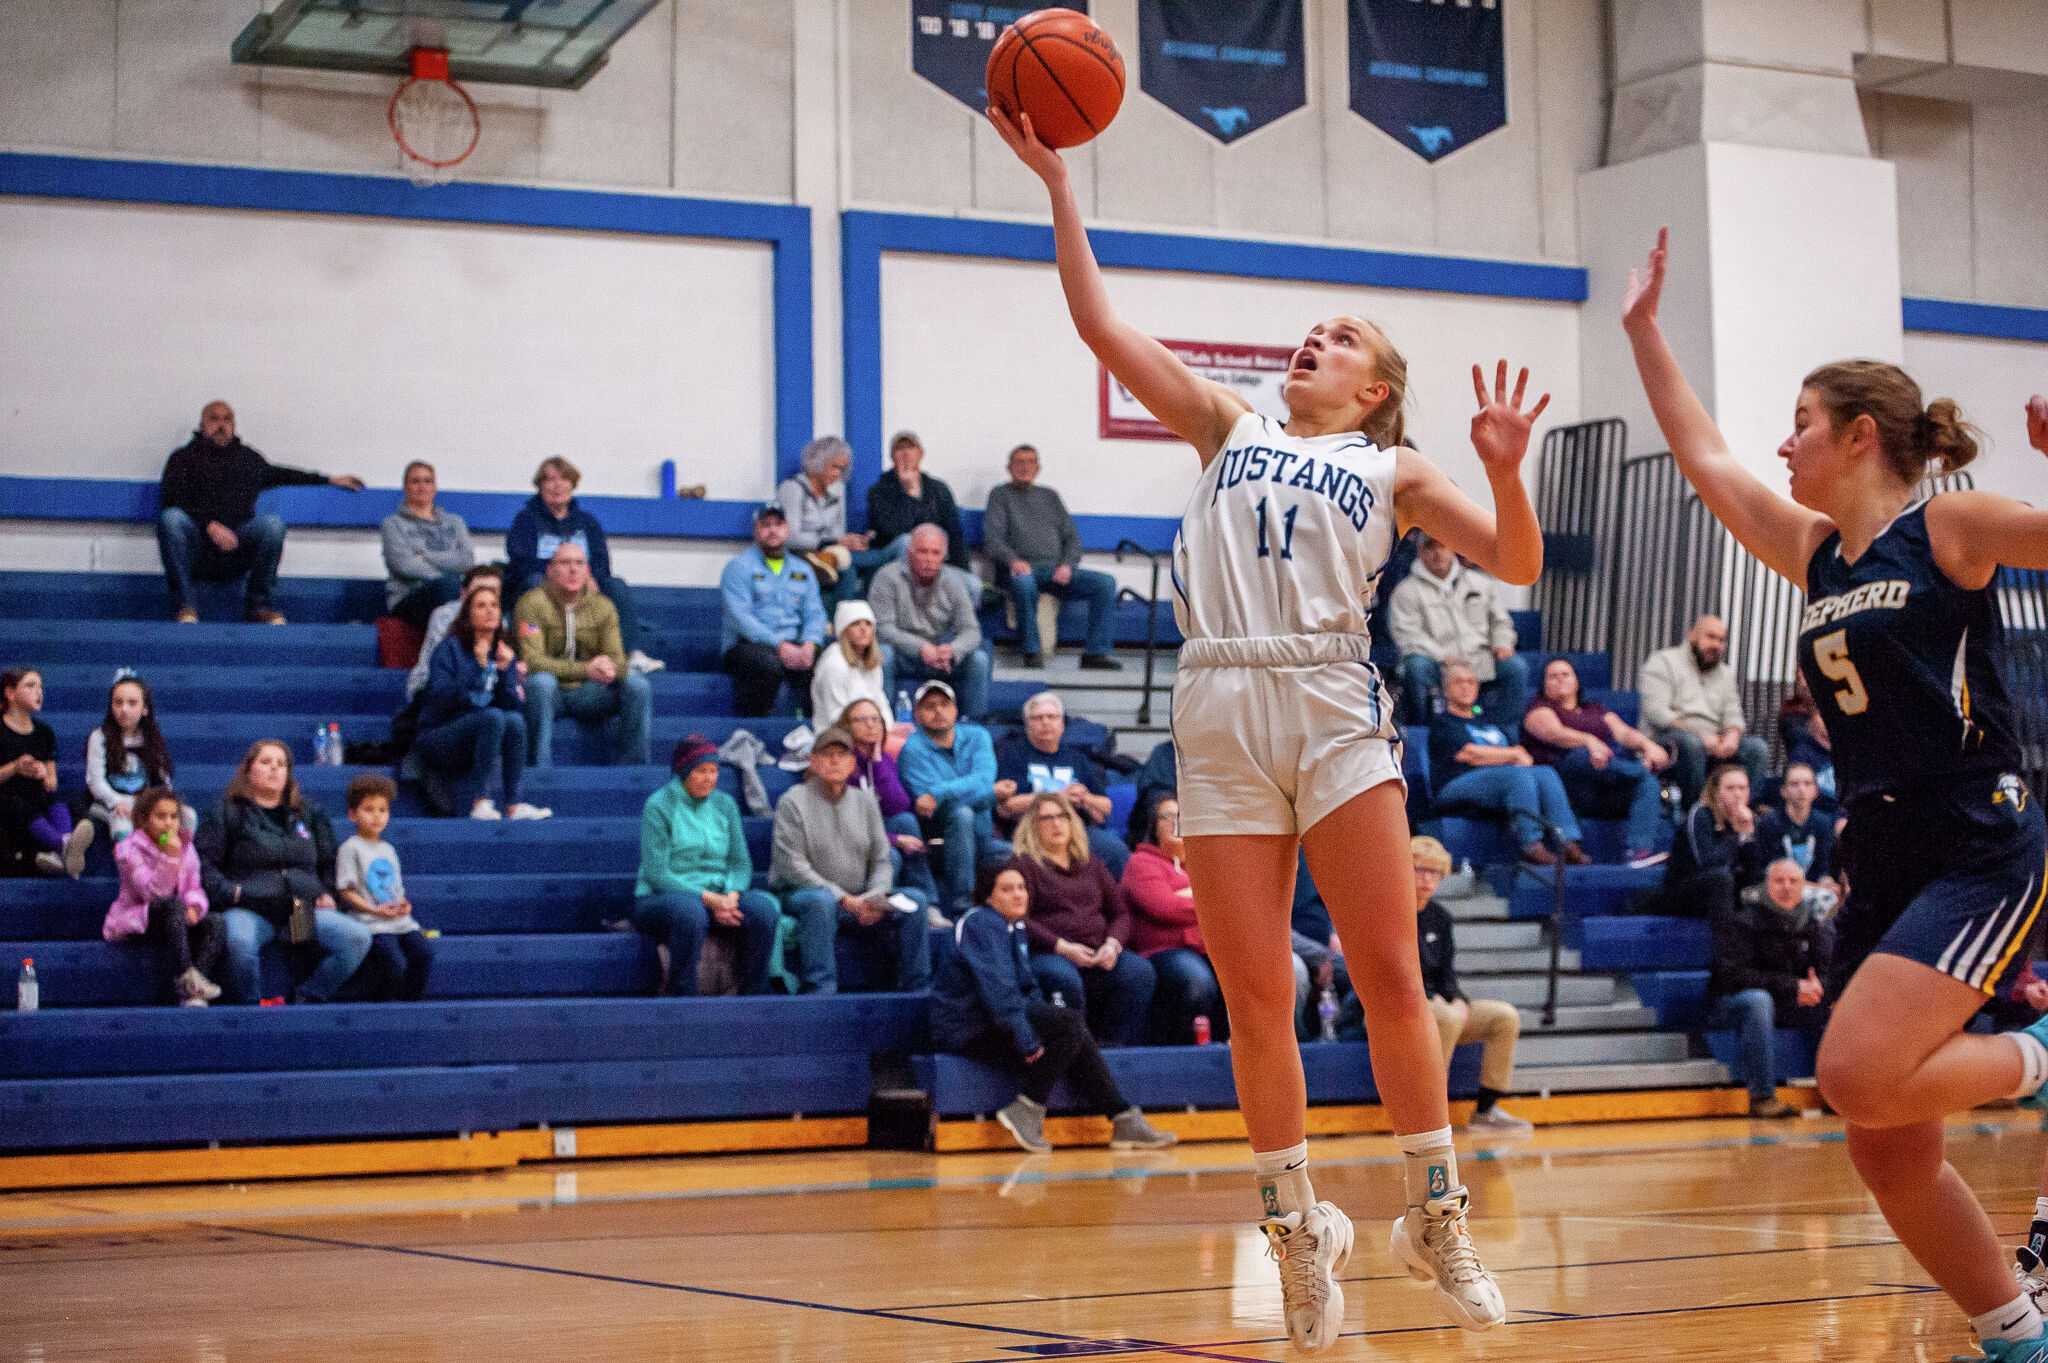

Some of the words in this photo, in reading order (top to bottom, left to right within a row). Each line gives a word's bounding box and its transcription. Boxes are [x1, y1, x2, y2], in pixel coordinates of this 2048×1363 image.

[1255, 496, 1300, 560] 11
[1800, 580, 1911, 635] EPHERD
[1813, 629, 1870, 716] 5
